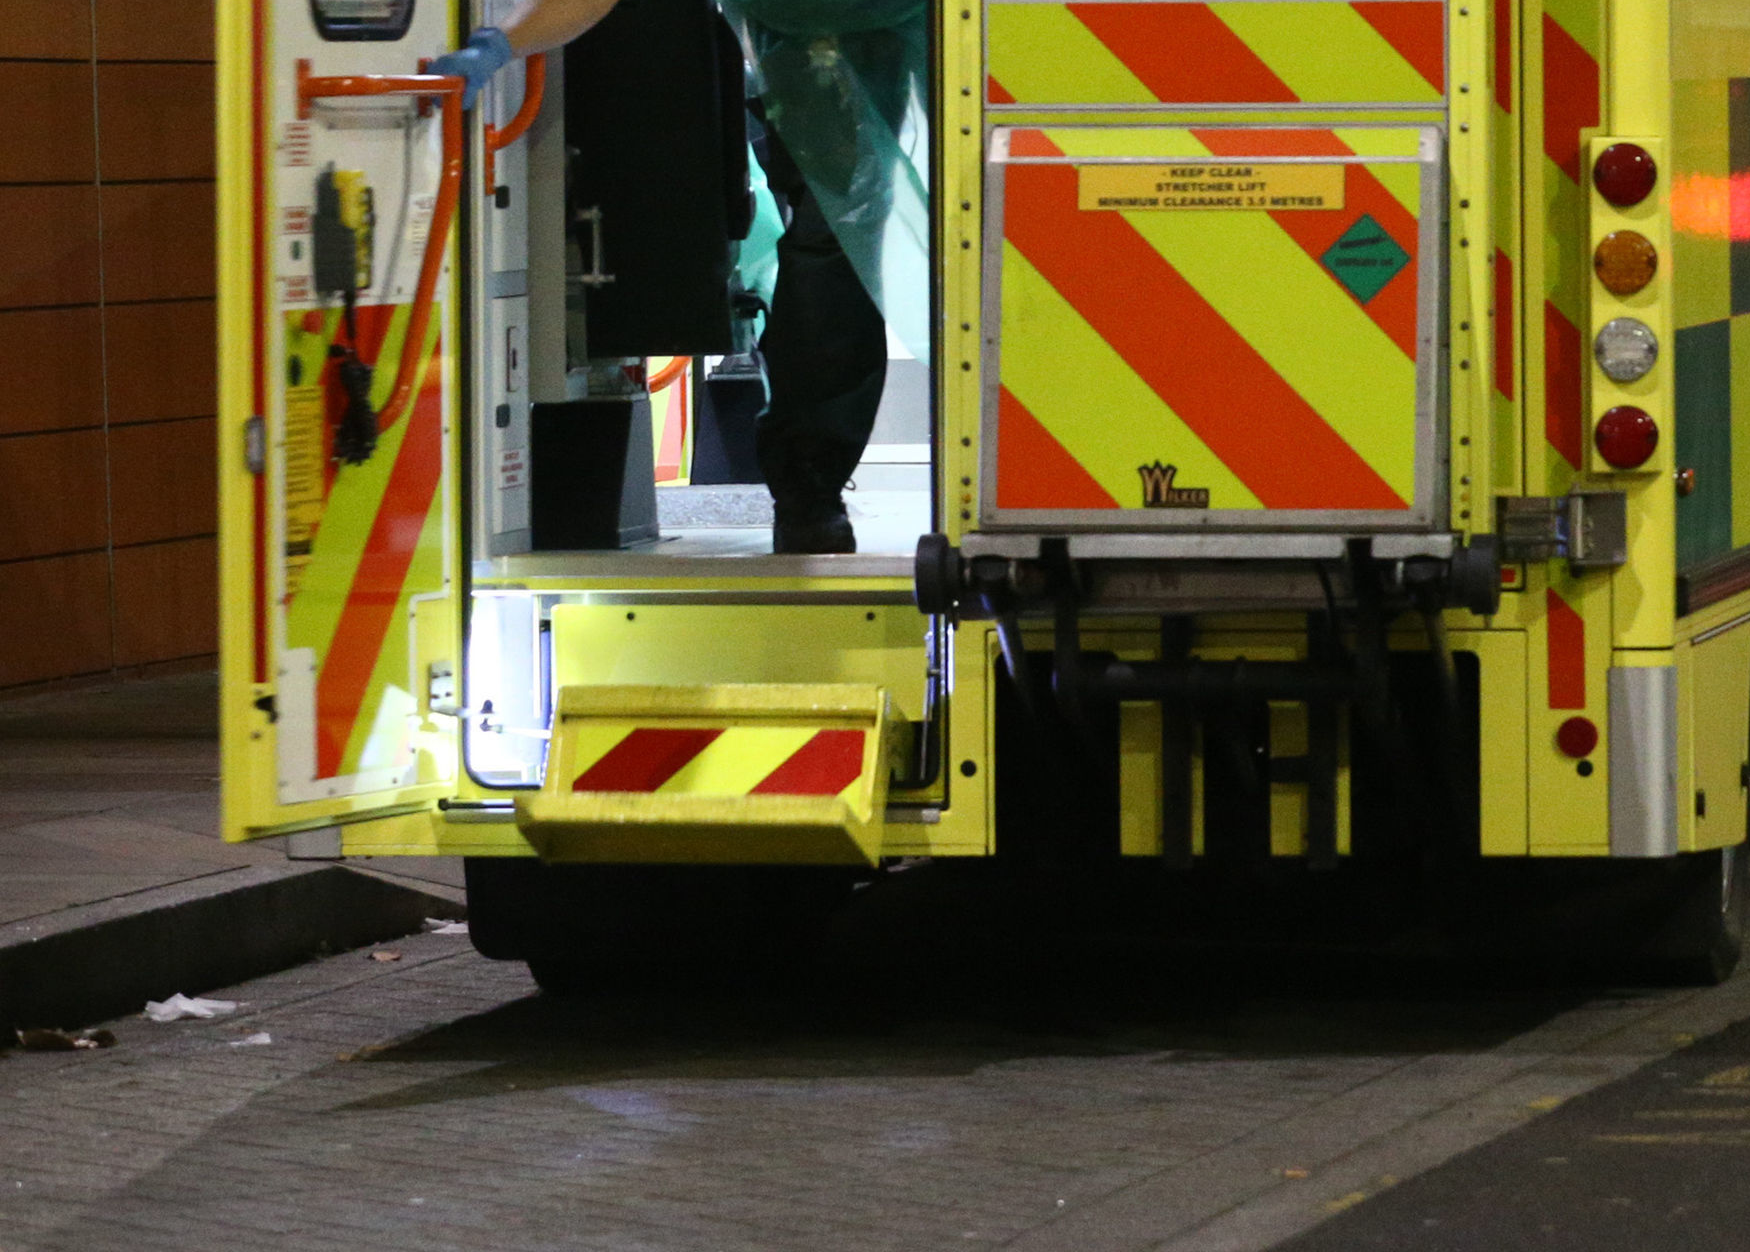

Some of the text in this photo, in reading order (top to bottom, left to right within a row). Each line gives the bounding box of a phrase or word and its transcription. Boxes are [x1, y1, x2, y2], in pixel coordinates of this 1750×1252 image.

[1170, 167, 1253, 178] KEEP CLEAR
[1155, 182, 1267, 193] STRETCHER LIFT
[1098, 196, 1160, 207] MINIMUM
[1163, 196, 1243, 207] CLEARANCE
[1270, 196, 1324, 207] METRES
